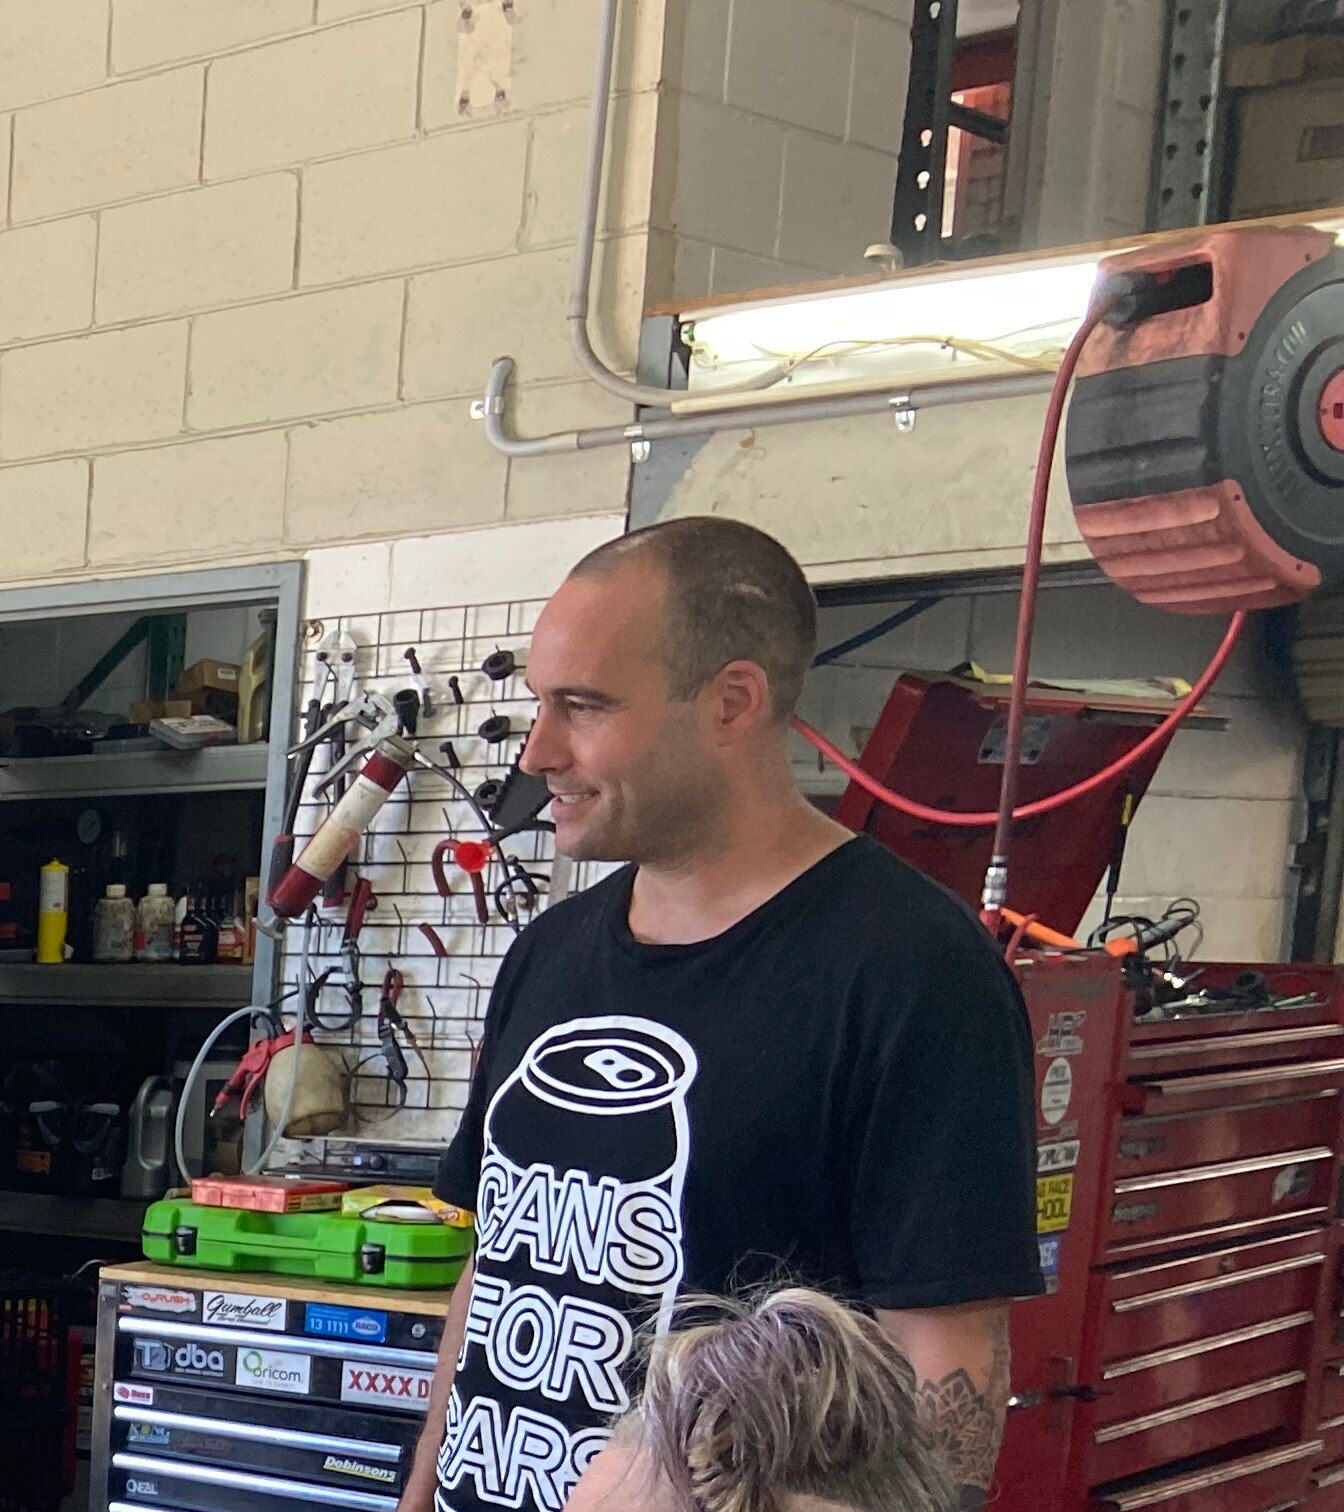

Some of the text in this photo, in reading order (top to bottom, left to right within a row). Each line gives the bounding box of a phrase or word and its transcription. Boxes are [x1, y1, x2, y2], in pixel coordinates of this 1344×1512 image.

[477, 1162, 682, 1294] CANS
[175, 1343, 224, 1372] dba
[348, 1369, 413, 1397] XXXX
[458, 1276, 631, 1412] FOR
